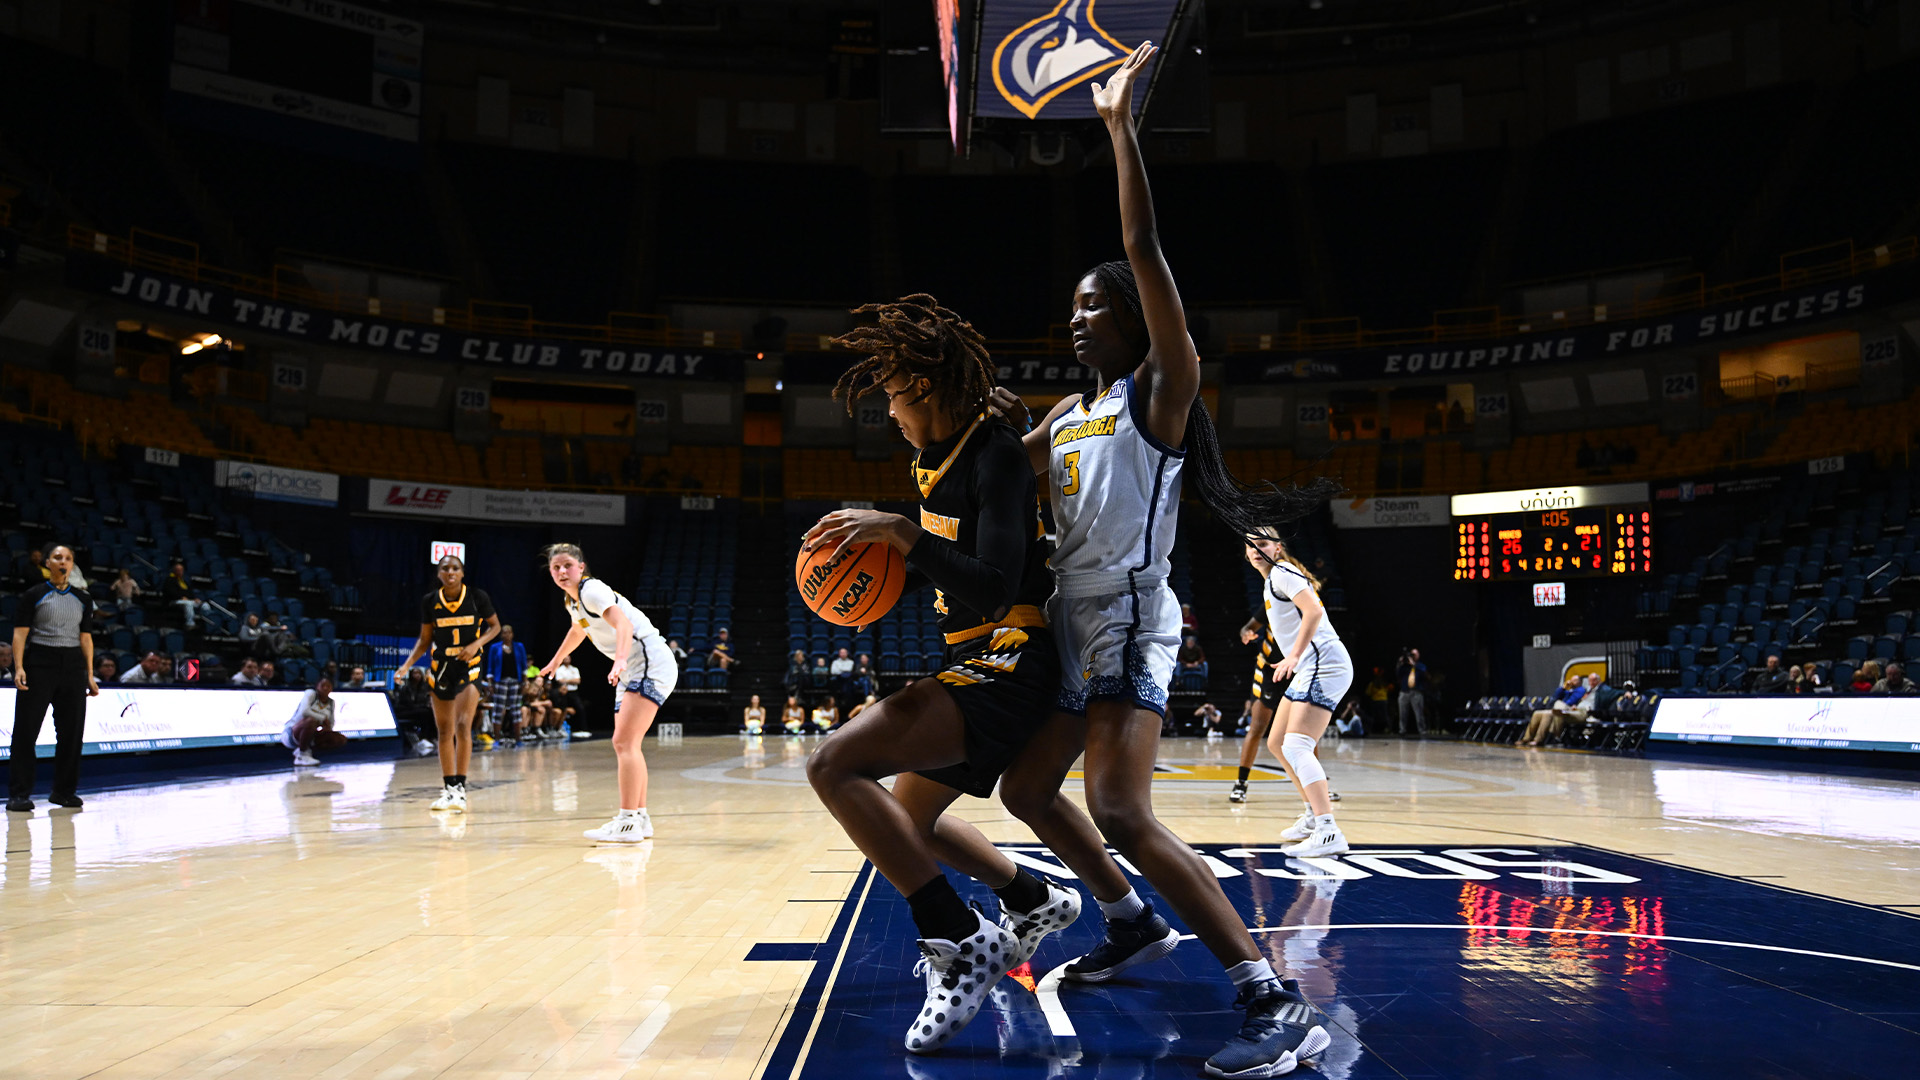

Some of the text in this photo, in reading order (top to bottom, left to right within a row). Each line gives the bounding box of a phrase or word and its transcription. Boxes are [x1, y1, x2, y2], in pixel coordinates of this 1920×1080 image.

[341, 8, 386, 31] MOCS
[111, 271, 703, 375] JOIN THE MOCS CLUB TODAY
[1384, 284, 1866, 374] EQUIPPING FOR SUCCESS
[84, 328, 110, 350] 218
[1865, 337, 1897, 361] 225
[277, 366, 304, 386] 219
[1664, 376, 1695, 394] 224
[460, 390, 486, 408] 219
[1478, 395, 1505, 413] 224
[640, 402, 665, 418] 220
[861, 408, 885, 424] 221
[1299, 406, 1326, 422] 223
[151, 450, 173, 460] 117
[259, 469, 322, 493] choices
[1062, 450, 1080, 496] 3
[409, 487, 452, 503] LEE
[1520, 490, 1575, 510] unum
[688, 499, 709, 509] 120
[1374, 499, 1419, 512] Steam
[1374, 511, 1431, 526] Logistics
[1541, 510, 1569, 527] 1:05
[1502, 538, 1522, 555] 26
[1544, 537, 1553, 552] 2
[1580, 534, 1601, 551] 21
[434, 544, 463, 562] EXIT
[1592, 554, 1601, 569] 2
[1501, 558, 1511, 573] 5
[1518, 558, 1528, 571] 4
[1571, 556, 1581, 569] 4
[831, 570, 875, 618] NCAA
[1536, 585, 1562, 604] EXIT
[452, 628, 460, 645] 1
